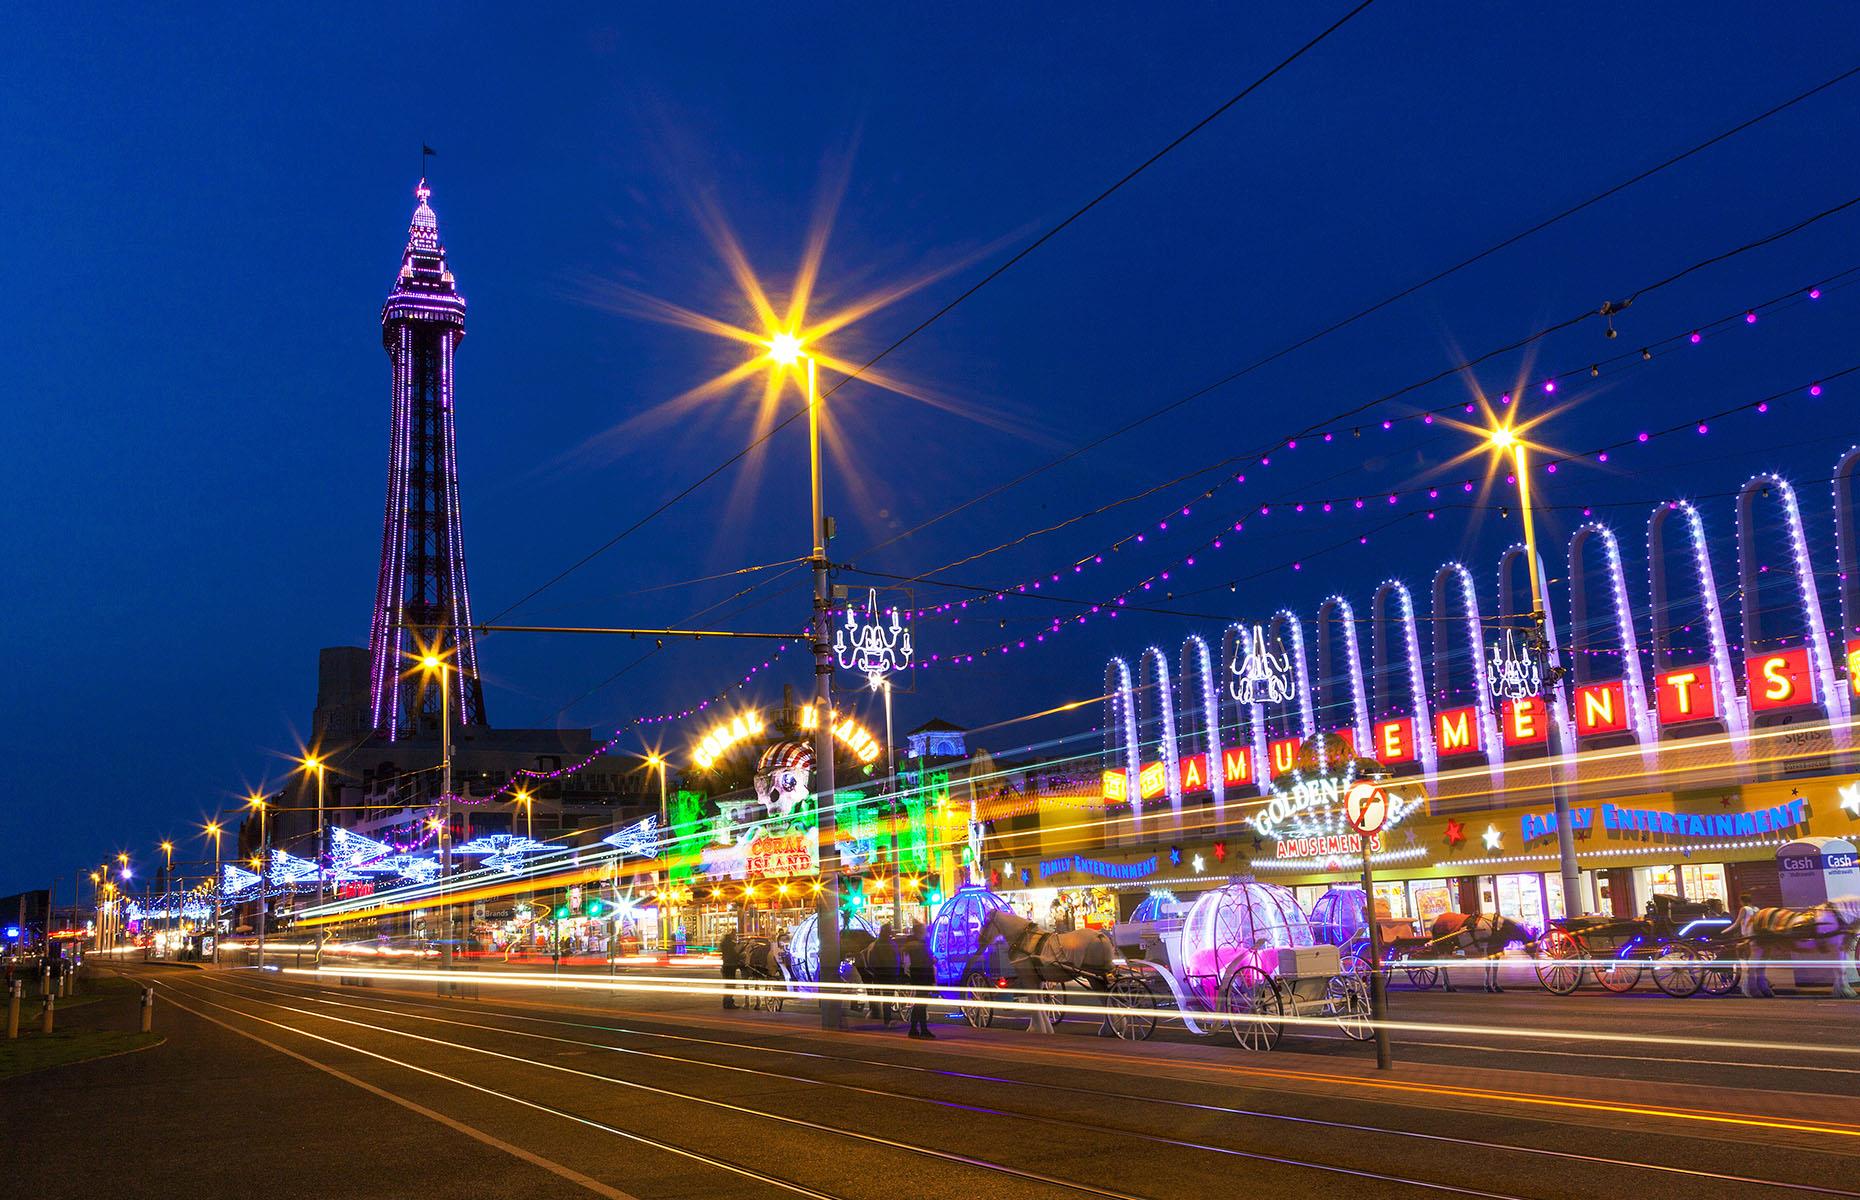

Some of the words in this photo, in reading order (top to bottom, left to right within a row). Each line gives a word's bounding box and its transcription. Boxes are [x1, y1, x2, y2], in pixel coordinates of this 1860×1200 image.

[1185, 657, 1795, 788] AMUEMENTS
[693, 710, 764, 769] CORAL
[1256, 777, 1339, 836] GOLDEN
[1521, 808, 1593, 843] FAMLY
[1602, 797, 1808, 837] ENTERTAINMENT
[752, 836, 808, 856] CORAL
[1276, 832, 1381, 859] AMUSEMENS
[745, 853, 812, 875] ISLAND
[1040, 857, 1072, 879] FAMILY
[1073, 853, 1158, 880] ENTERTAINMENT
[1784, 856, 1814, 870] Cash
[1827, 854, 1852, 868] Cash
[485, 909, 509, 918] Brands
